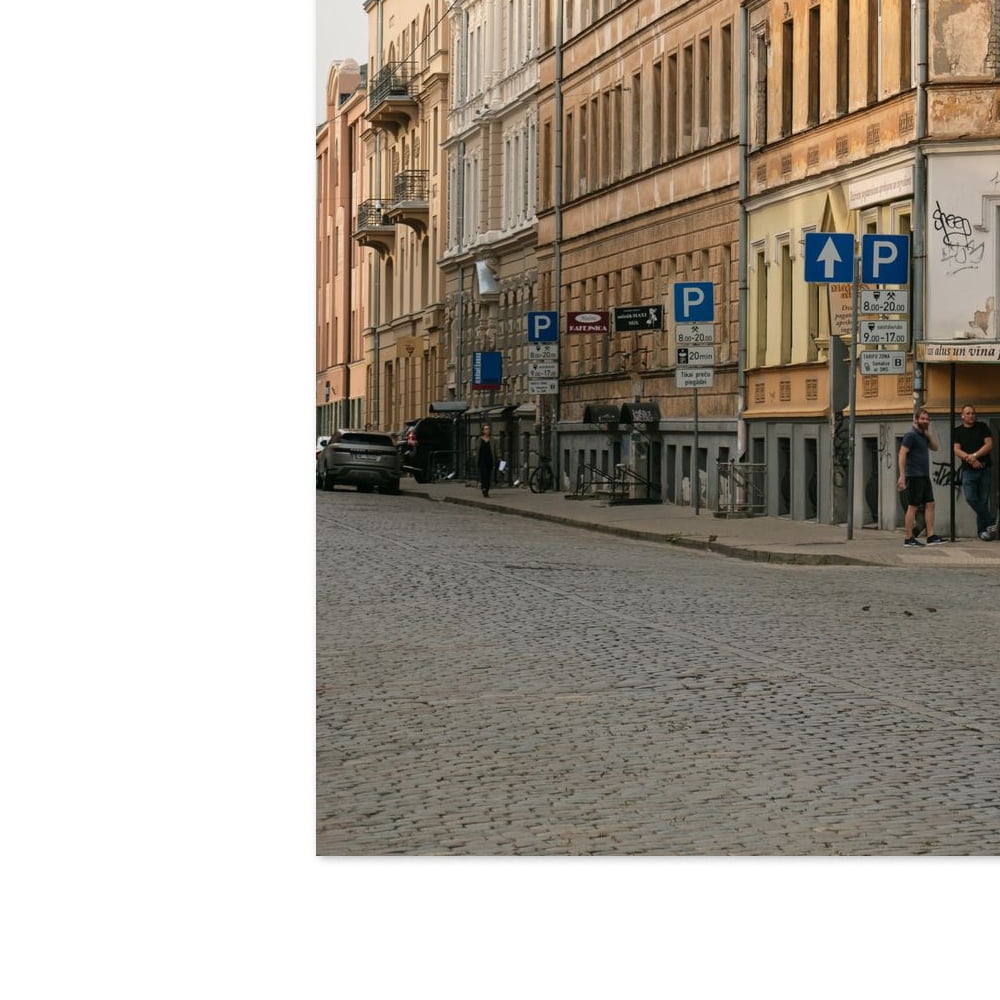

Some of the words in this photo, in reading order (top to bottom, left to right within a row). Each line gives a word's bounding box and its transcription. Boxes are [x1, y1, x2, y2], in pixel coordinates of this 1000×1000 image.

[873, 241, 898, 278] P
[683, 287, 705, 317] P
[863, 301, 905, 312] 8.00-20.00
[535, 315, 551, 338] P
[953, 347, 966, 356] un
[968, 346, 995, 357] vīna
[894, 358, 902, 366] B
